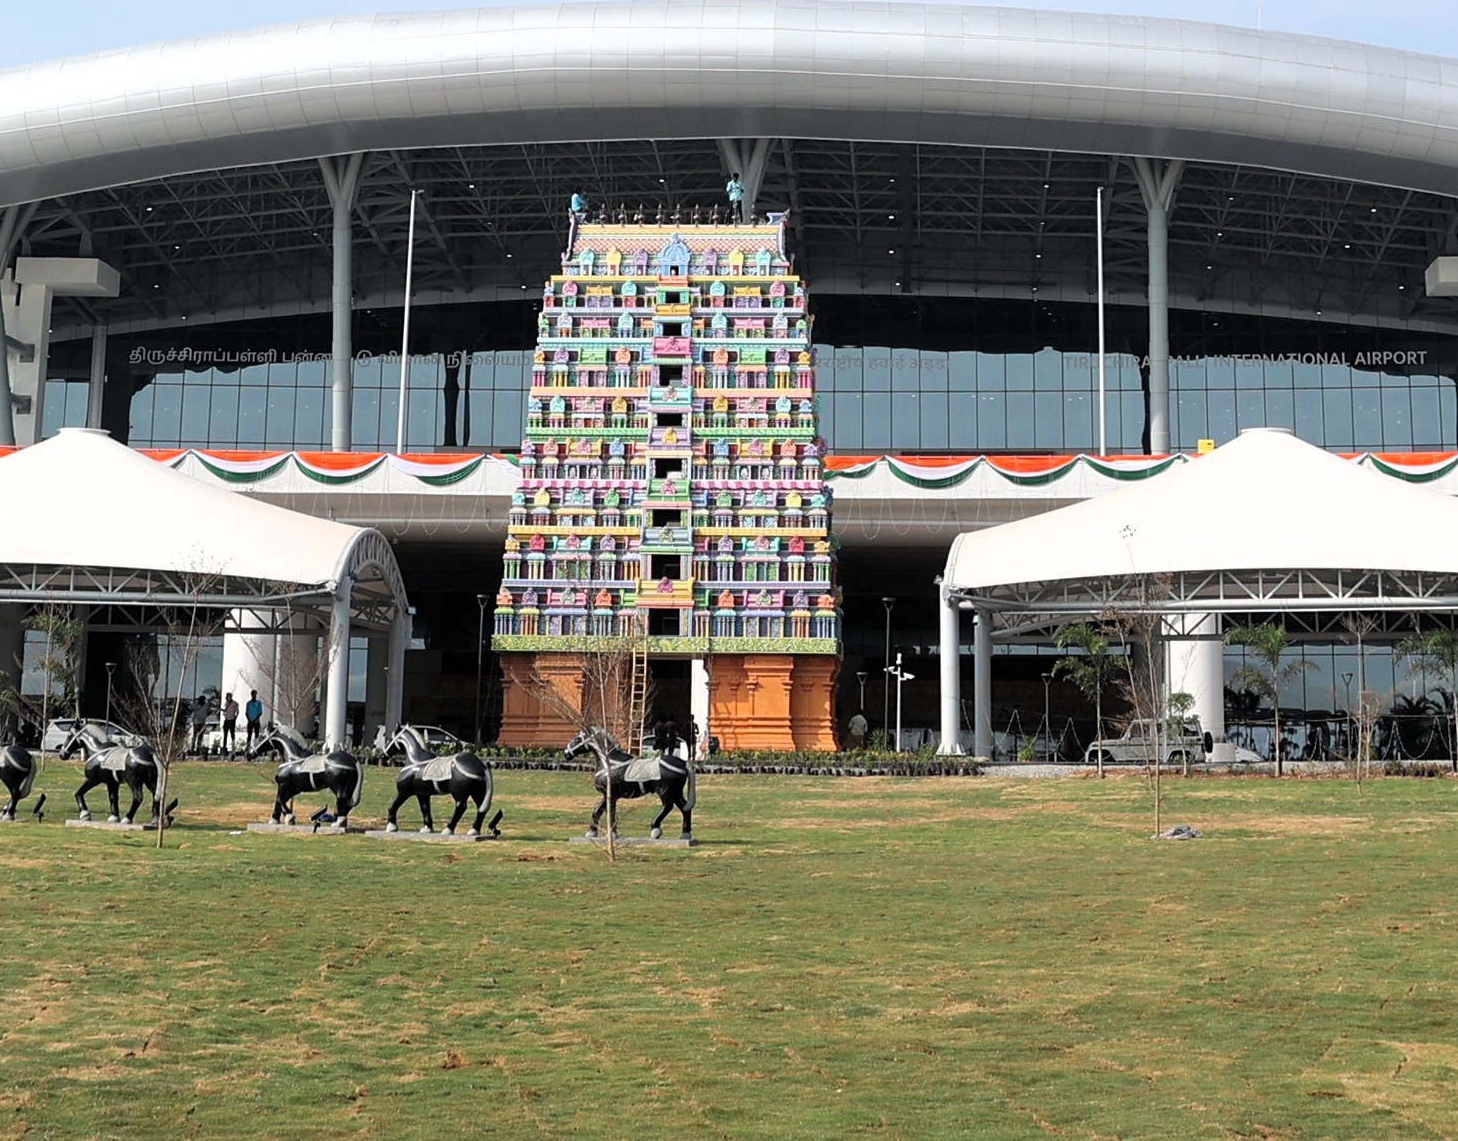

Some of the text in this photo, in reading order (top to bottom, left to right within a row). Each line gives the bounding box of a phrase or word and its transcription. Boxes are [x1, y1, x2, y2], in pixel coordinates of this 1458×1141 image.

[128, 345, 277, 365] திருச்சிராப்பள்ளி
[282, 348, 373, 368] பன்னடு
[1064, 349, 1428, 370] TIRUCHIRAPALLI INTERNATIONAL AIRPORT
